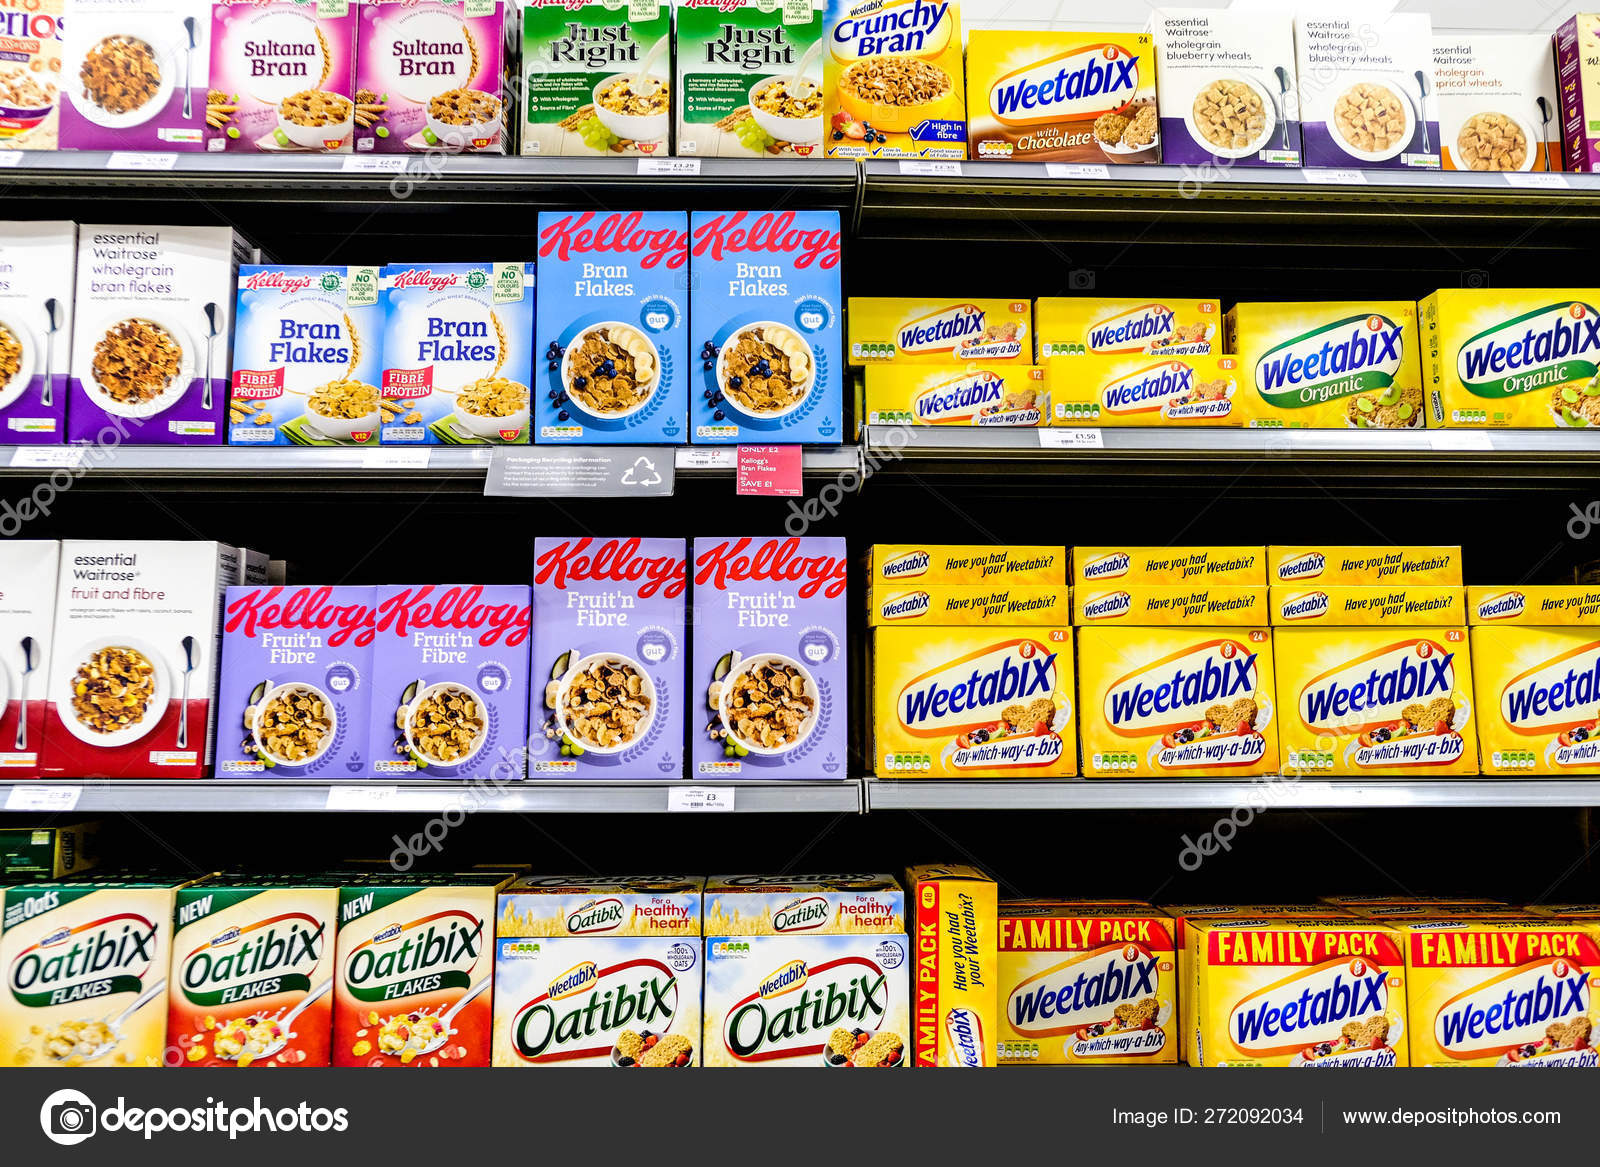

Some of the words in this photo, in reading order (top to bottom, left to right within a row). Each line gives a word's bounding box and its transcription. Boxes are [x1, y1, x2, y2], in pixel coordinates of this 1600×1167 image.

[834, 0, 949, 43] Crunchy
[1165, 18, 1209, 27] essential
[566, 22, 631, 44] Just
[720, 24, 786, 46] Just
[857, 29, 926, 57] Bran
[244, 40, 316, 57] Sultana
[392, 39, 464, 56] Sultana
[549, 39, 640, 68] Right
[704, 39, 796, 69] Right
[1166, 40, 1221, 50] wholegrain
[399, 59, 456, 76] Bran
[1167, 52, 1215, 62] blueberry
[1217, 52, 1252, 61] wheats
[251, 60, 307, 76] Bran
[997, 56, 1140, 115] Weetabix
[931, 122, 952, 131] High
[937, 131, 958, 139] fibre
[1036, 128, 1059, 137] with
[1017, 133, 1091, 150] Chocolate
[93, 232, 160, 246] essential
[93, 248, 158, 260] Waitrose
[92, 263, 174, 278] wholegrain
[395, 269, 459, 291] Kellogg's
[501, 271, 515, 279] NO
[582, 264, 627, 279] Bran
[736, 264, 782, 279] Bran
[91, 281, 126, 293] bran
[129, 280, 172, 294] flakes
[246, 271, 312, 293] Kellogg's
[575, 280, 635, 297] Flakes
[728, 280, 788, 297] Flakes
[279, 319, 341, 339] Bran
[427, 318, 487, 337] Bran
[649, 315, 666, 324] gut
[803, 315, 820, 324] gut
[901, 311, 986, 349] Weetabix
[1091, 311, 1175, 349] Weetabix
[269, 342, 349, 363] Flakes
[417, 340, 495, 361] Flakes
[1263, 326, 1404, 391] Weetabix
[1465, 316, 1600, 381] Weetabix
[239, 375, 276, 384] FIBRE
[389, 374, 424, 383] FIBRE
[1105, 368, 1194, 409] Weetabix
[1300, 375, 1364, 403] Organic
[1503, 364, 1568, 393] Organic
[233, 386, 282, 398] PROTEIN
[383, 385, 431, 397] PROTEIN
[918, 378, 1004, 416] Weetabix
[74, 554, 136, 566] essential
[73, 569, 135, 581] Waitrose
[71, 587, 99, 600] fruit
[103, 588, 129, 600] and
[133, 588, 166, 600] fibre
[567, 592, 635, 609] Fruit'n
[728, 592, 796, 609] Fruit'n
[577, 610, 627, 627] Fibre
[738, 610, 789, 627] Fibre
[262, 633, 322, 648] Fruit'n
[413, 632, 473, 648] Fruit'n
[270, 650, 316, 664] Fibre
[422, 650, 467, 664] Fibre
[906, 653, 1058, 725] Weetabix
[1111, 653, 1257, 725] Weetabix
[1307, 653, 1455, 723] Weetabix
[955, 737, 1063, 764] Any-which-way-a-bix
[1160, 737, 1266, 765] Any-which-way-a-bix
[1357, 737, 1463, 763] Any-which-way-a-bix
[179, 896, 213, 925] NEW
[343, 893, 374, 922] NEW
[567, 904, 622, 932] Oatibix
[634, 903, 689, 919] healthy
[773, 902, 829, 931] Oatibix
[839, 901, 893, 917] healthy
[650, 915, 689, 929] heart
[1000, 920, 1093, 949] FAMILY
[1101, 920, 1151, 942] PACK
[15, 922, 158, 989] Oatibix
[185, 921, 325, 988] Oatibix
[347, 920, 484, 984] Oatibix
[1218, 932, 1316, 963] FAMILY
[1325, 933, 1379, 956] PACK
[1422, 933, 1519, 965] FAMILY
[1528, 935, 1581, 956] PACK
[384, 974, 442, 1000] FLAKES
[548, 964, 598, 998] Weetabix
[759, 962, 808, 997] Weetabix
[51, 979, 113, 1004] FLAKES
[221, 978, 282, 1004] FLAKES
[1015, 956, 1160, 1025] Weetabix
[516, 973, 678, 1058] Oatibix
[728, 973, 887, 1057] Oatibix
[1237, 971, 1389, 1043] Weetabix
[1443, 972, 1590, 1047] Weetabix
